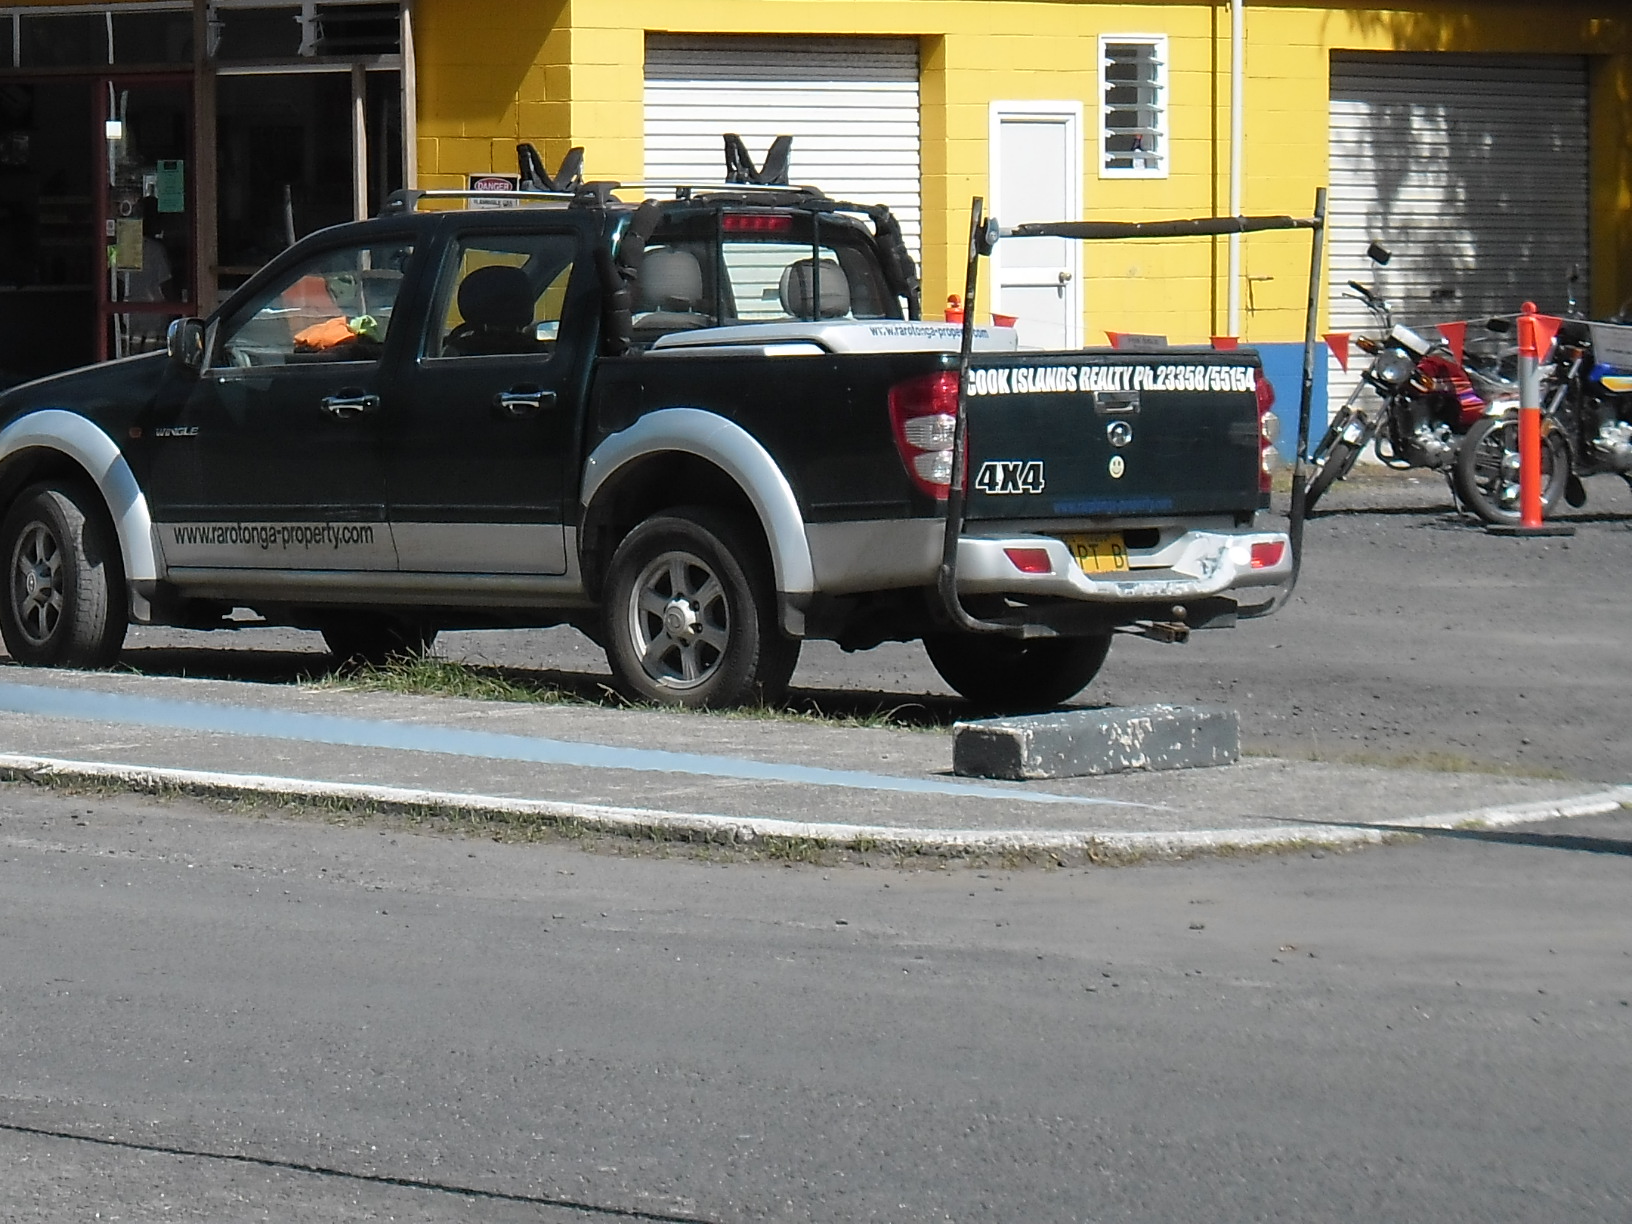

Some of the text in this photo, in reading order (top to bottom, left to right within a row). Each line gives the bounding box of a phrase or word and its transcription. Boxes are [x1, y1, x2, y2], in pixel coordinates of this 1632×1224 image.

[477, 182, 509, 190] DANGER
[967, 368, 1011, 397] COOK
[1011, 366, 1078, 394] ISLANDS
[1079, 365, 1134, 392] REALTY
[156, 426, 199, 437] WINGLE
[975, 460, 1045, 494] 4X4
[174, 524, 374, 550] www.rarotonga-property.com
